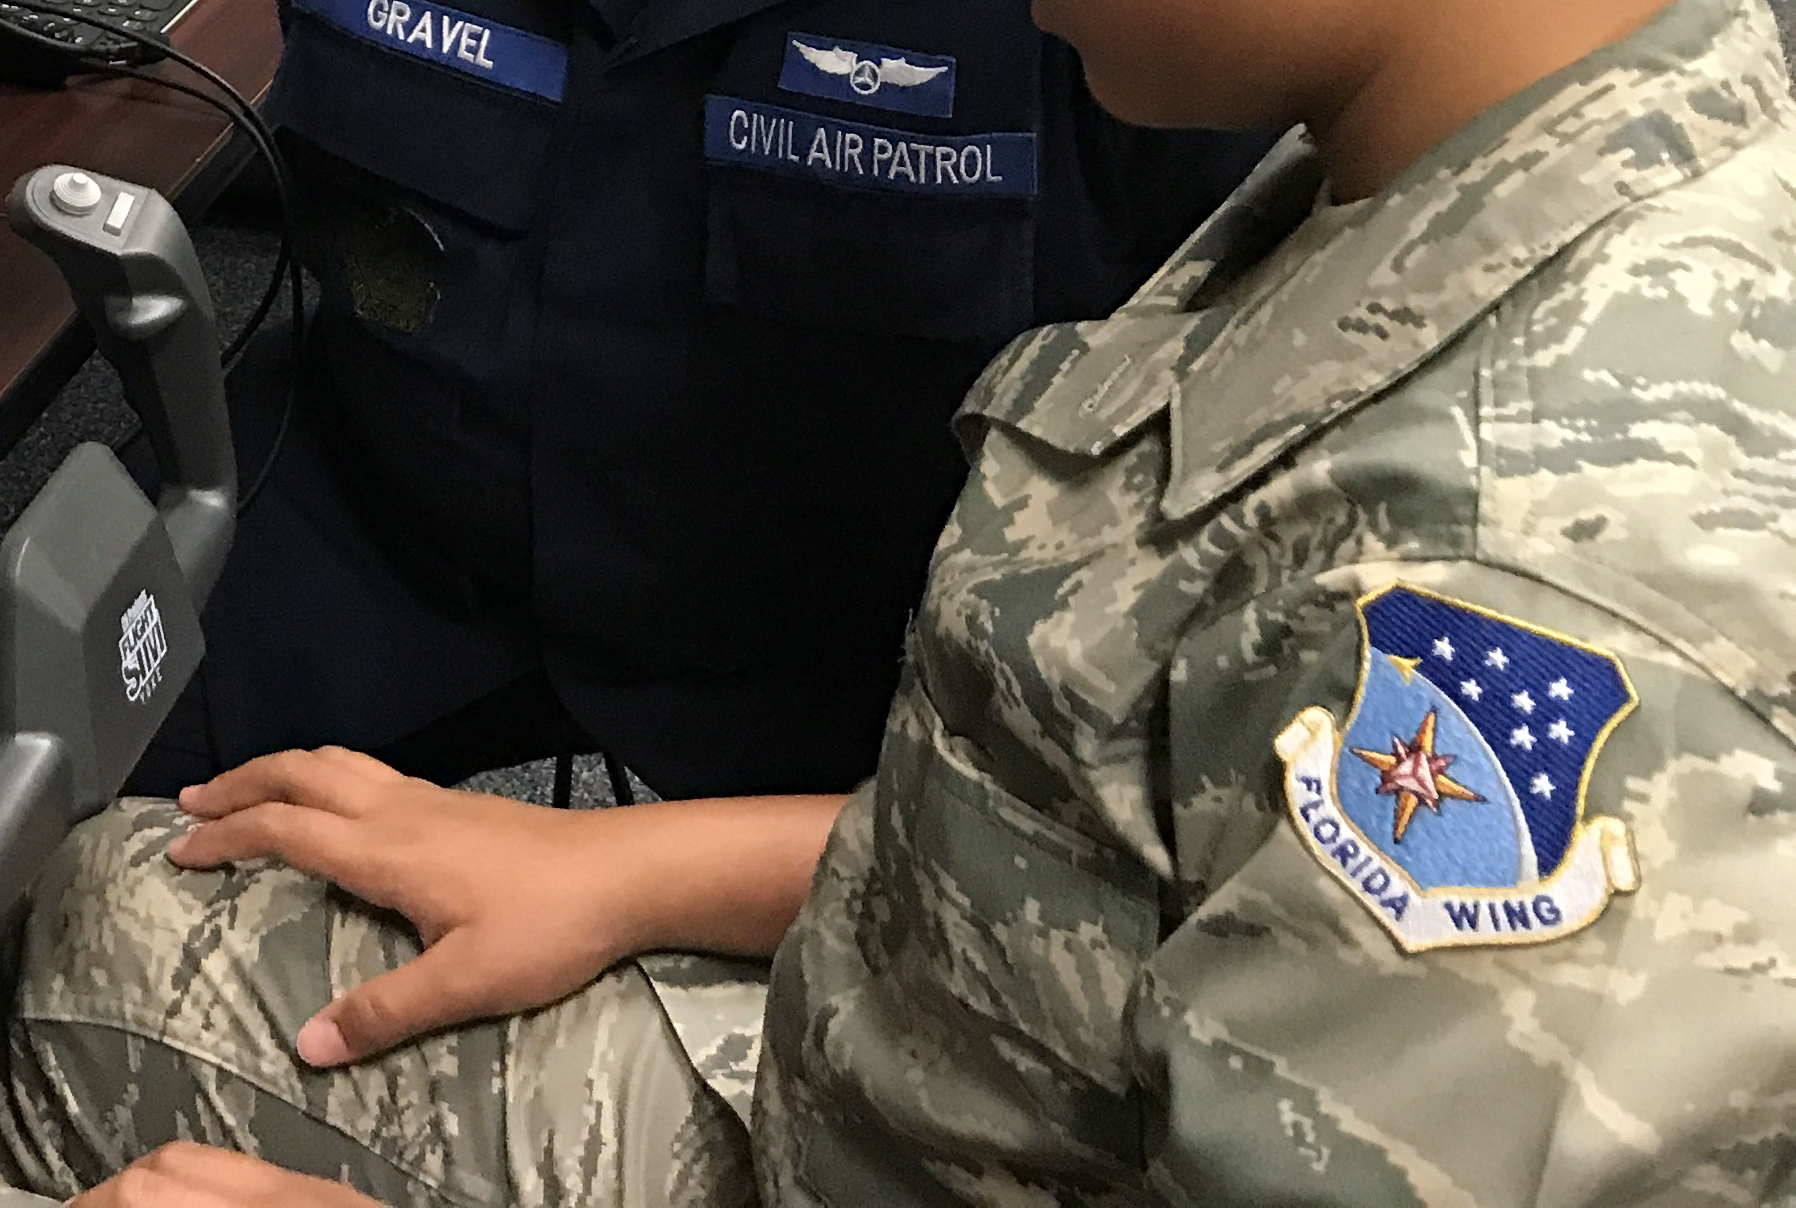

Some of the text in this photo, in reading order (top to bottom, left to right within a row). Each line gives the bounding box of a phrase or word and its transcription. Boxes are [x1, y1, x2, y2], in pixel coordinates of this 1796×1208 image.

[729, 109, 1003, 184] CIVIL AIR PATROL
[1298, 775, 1563, 932] FLORIDA WING
